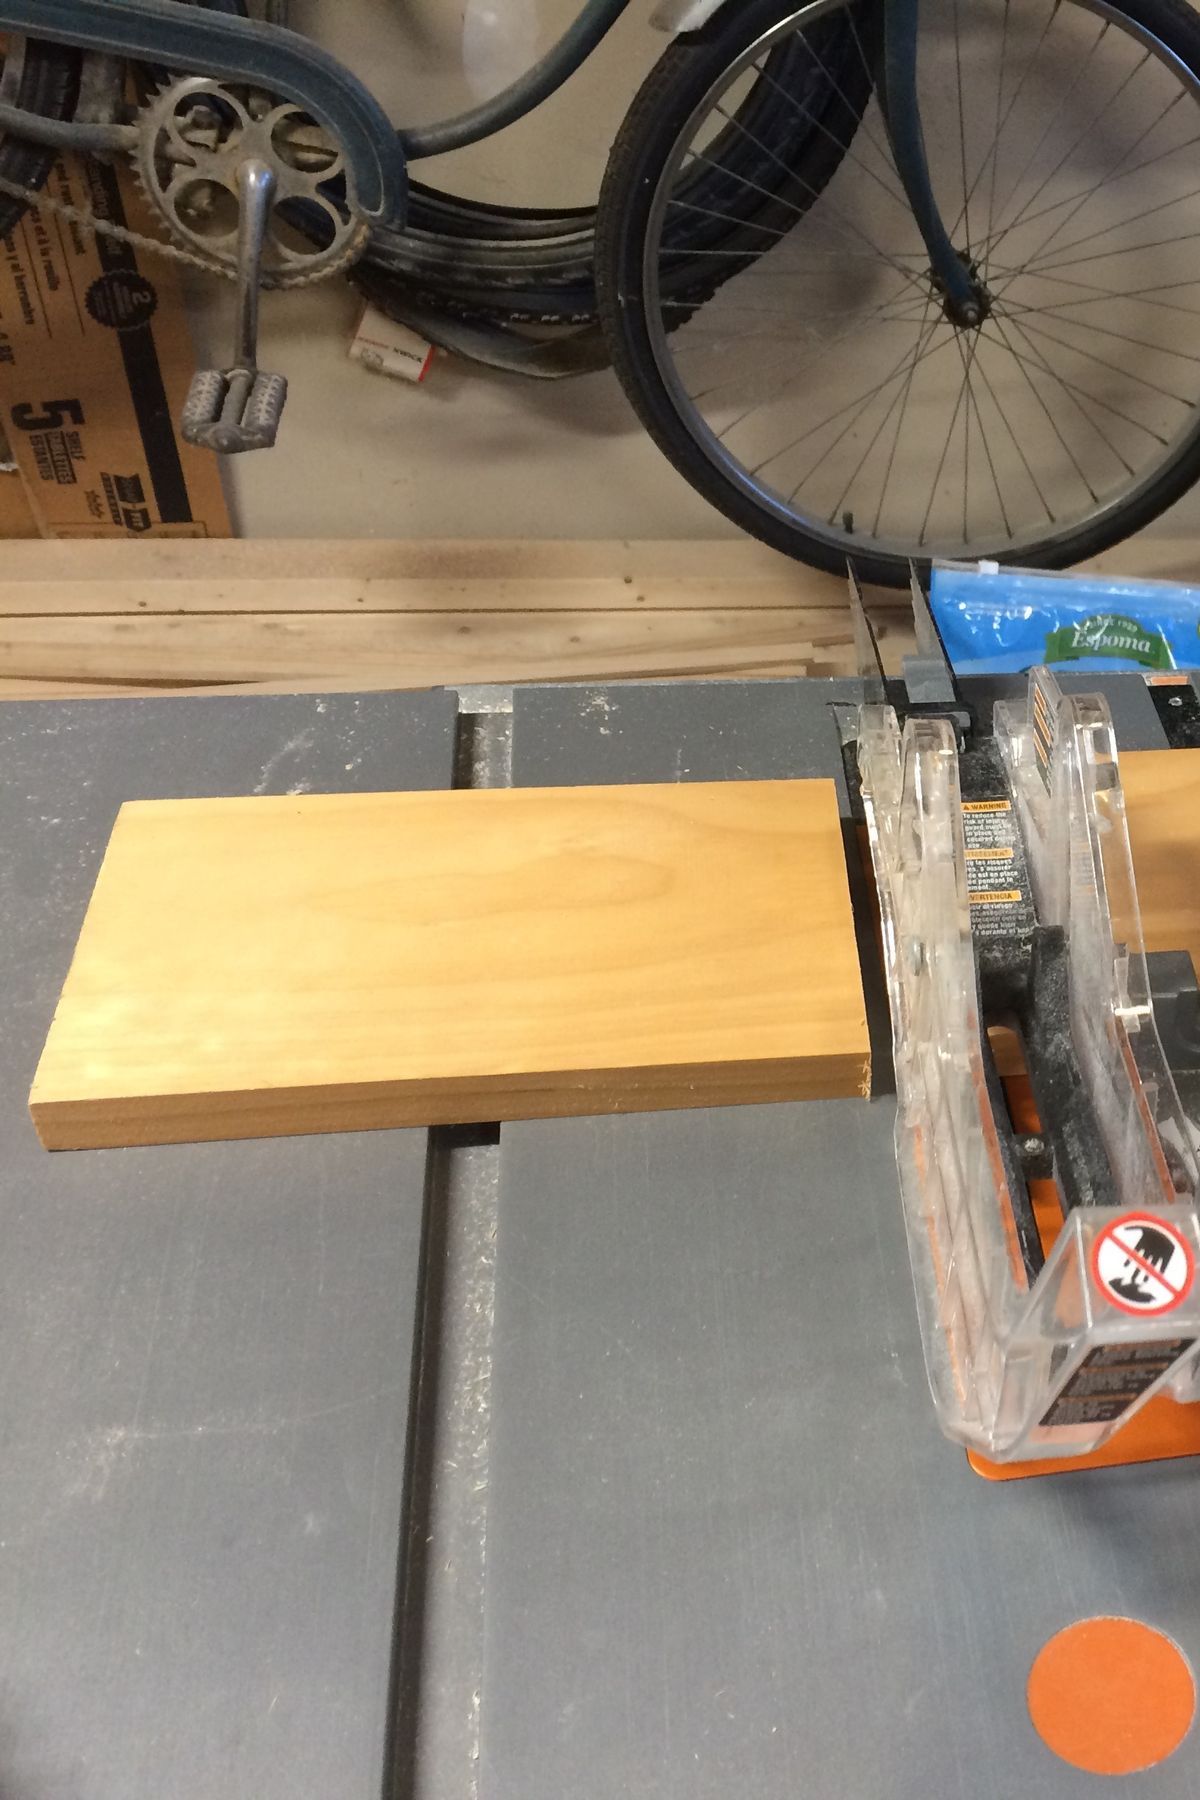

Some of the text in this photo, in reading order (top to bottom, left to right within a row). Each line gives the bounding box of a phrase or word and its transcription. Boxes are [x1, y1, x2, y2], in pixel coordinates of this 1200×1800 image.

[11, 398, 86, 431] 5
[1071, 630, 1151, 654] Espoma
[972, 801, 1007, 811] WARNING
